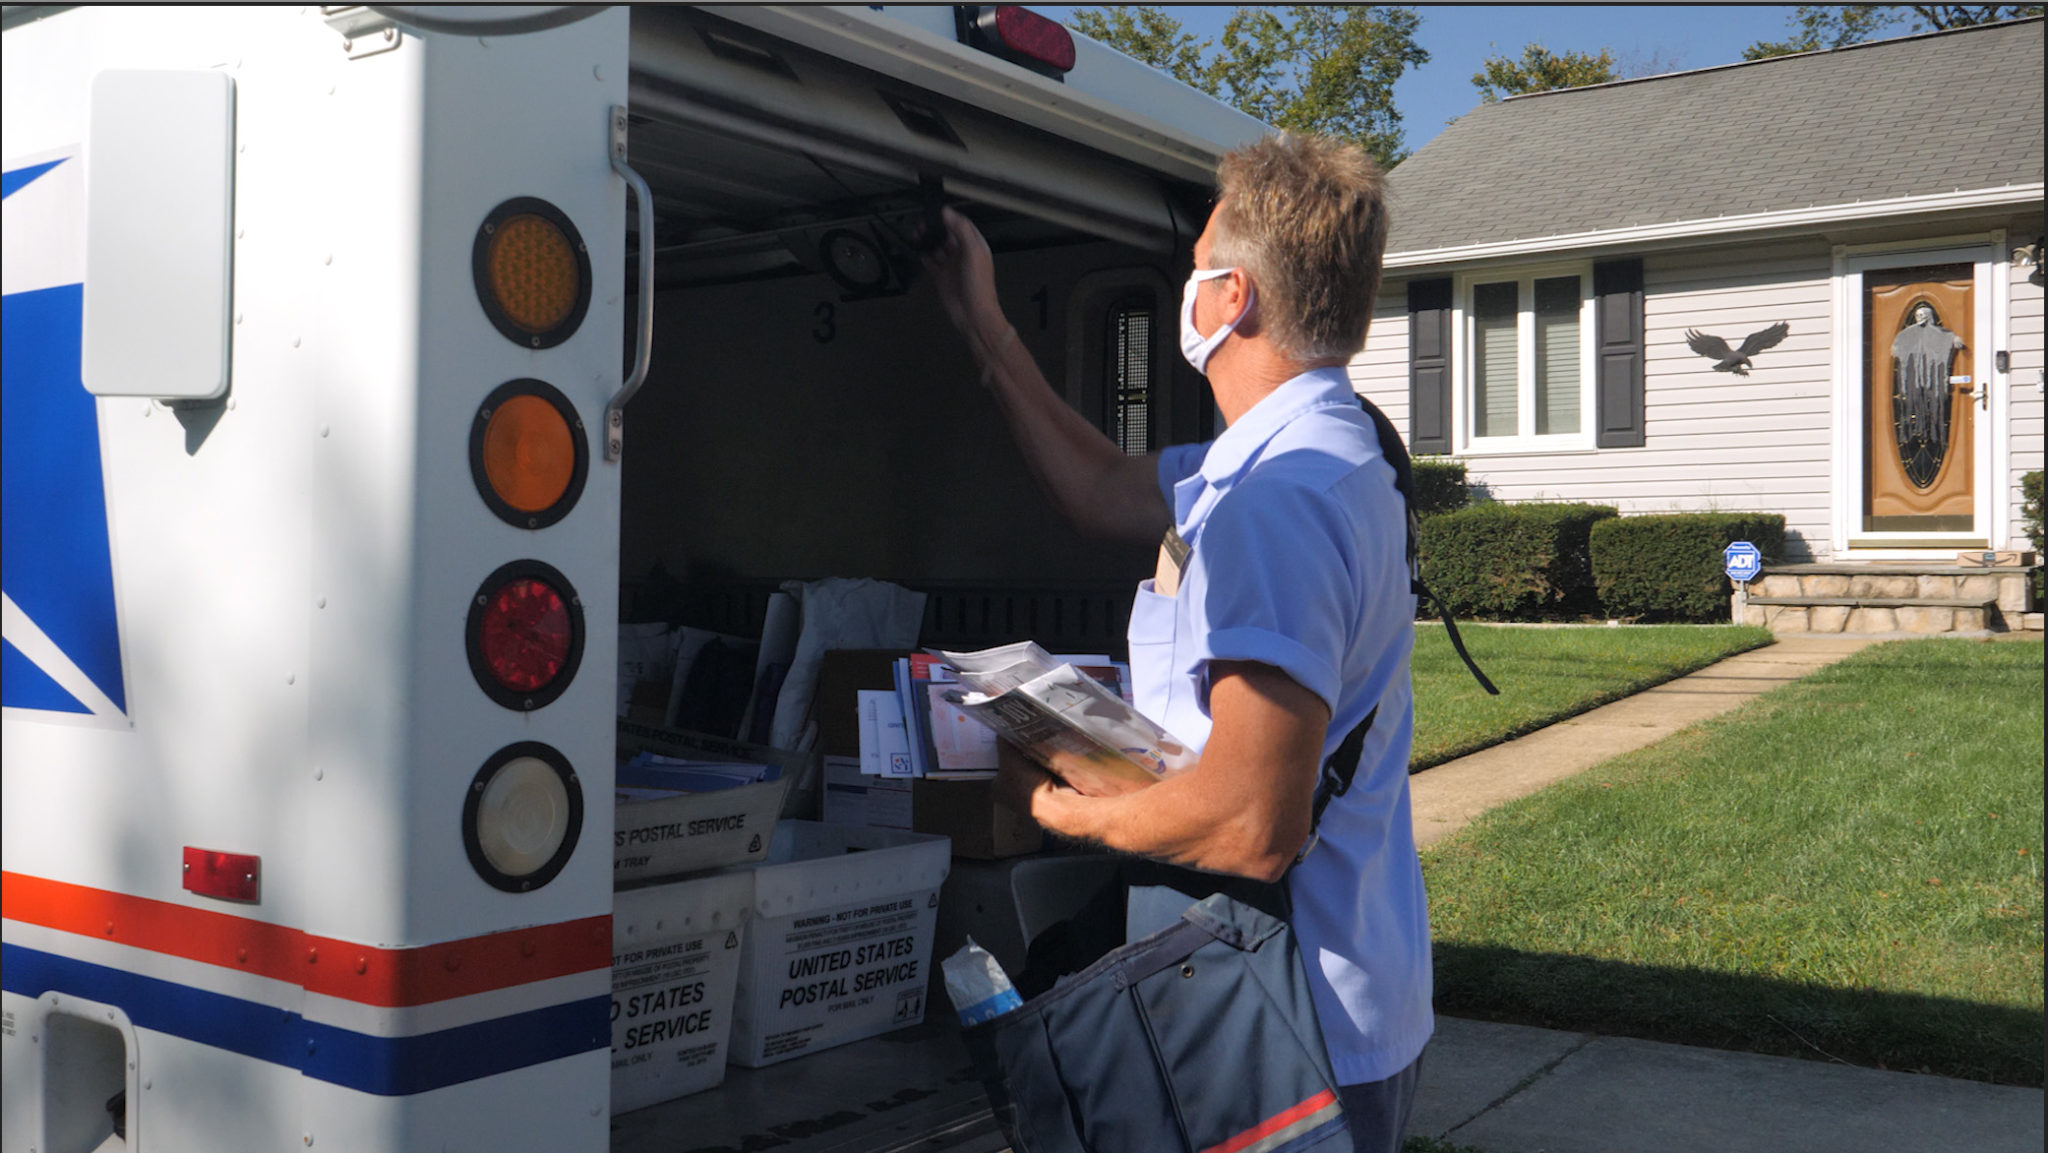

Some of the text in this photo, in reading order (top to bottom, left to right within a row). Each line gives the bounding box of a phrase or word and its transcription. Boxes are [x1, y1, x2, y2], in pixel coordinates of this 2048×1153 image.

[812, 301, 836, 343] 3
[1031, 285, 1048, 330] 1
[1728, 555, 1754, 568] ADT
[629, 822, 684, 846] POSTAL
[688, 814, 746, 837] SERVICE
[623, 856, 651, 869] TRAY
[794, 915, 830, 928] WARNING
[837, 910, 852, 921] NOT
[853, 907, 868, 918] FOR
[870, 902, 898, 915] PRIVATE
[900, 899, 913, 909] USE
[624, 951, 643, 964] FOR
[646, 944, 683, 960] PRIVATE
[685, 940, 703, 952] USE
[789, 951, 851, 979] UNITED
[856, 936, 914, 965] STATES
[627, 982, 705, 1018] STATES
[780, 961, 918, 1009] POSTAL SERVICE
[625, 1009, 712, 1049] SERVICE
